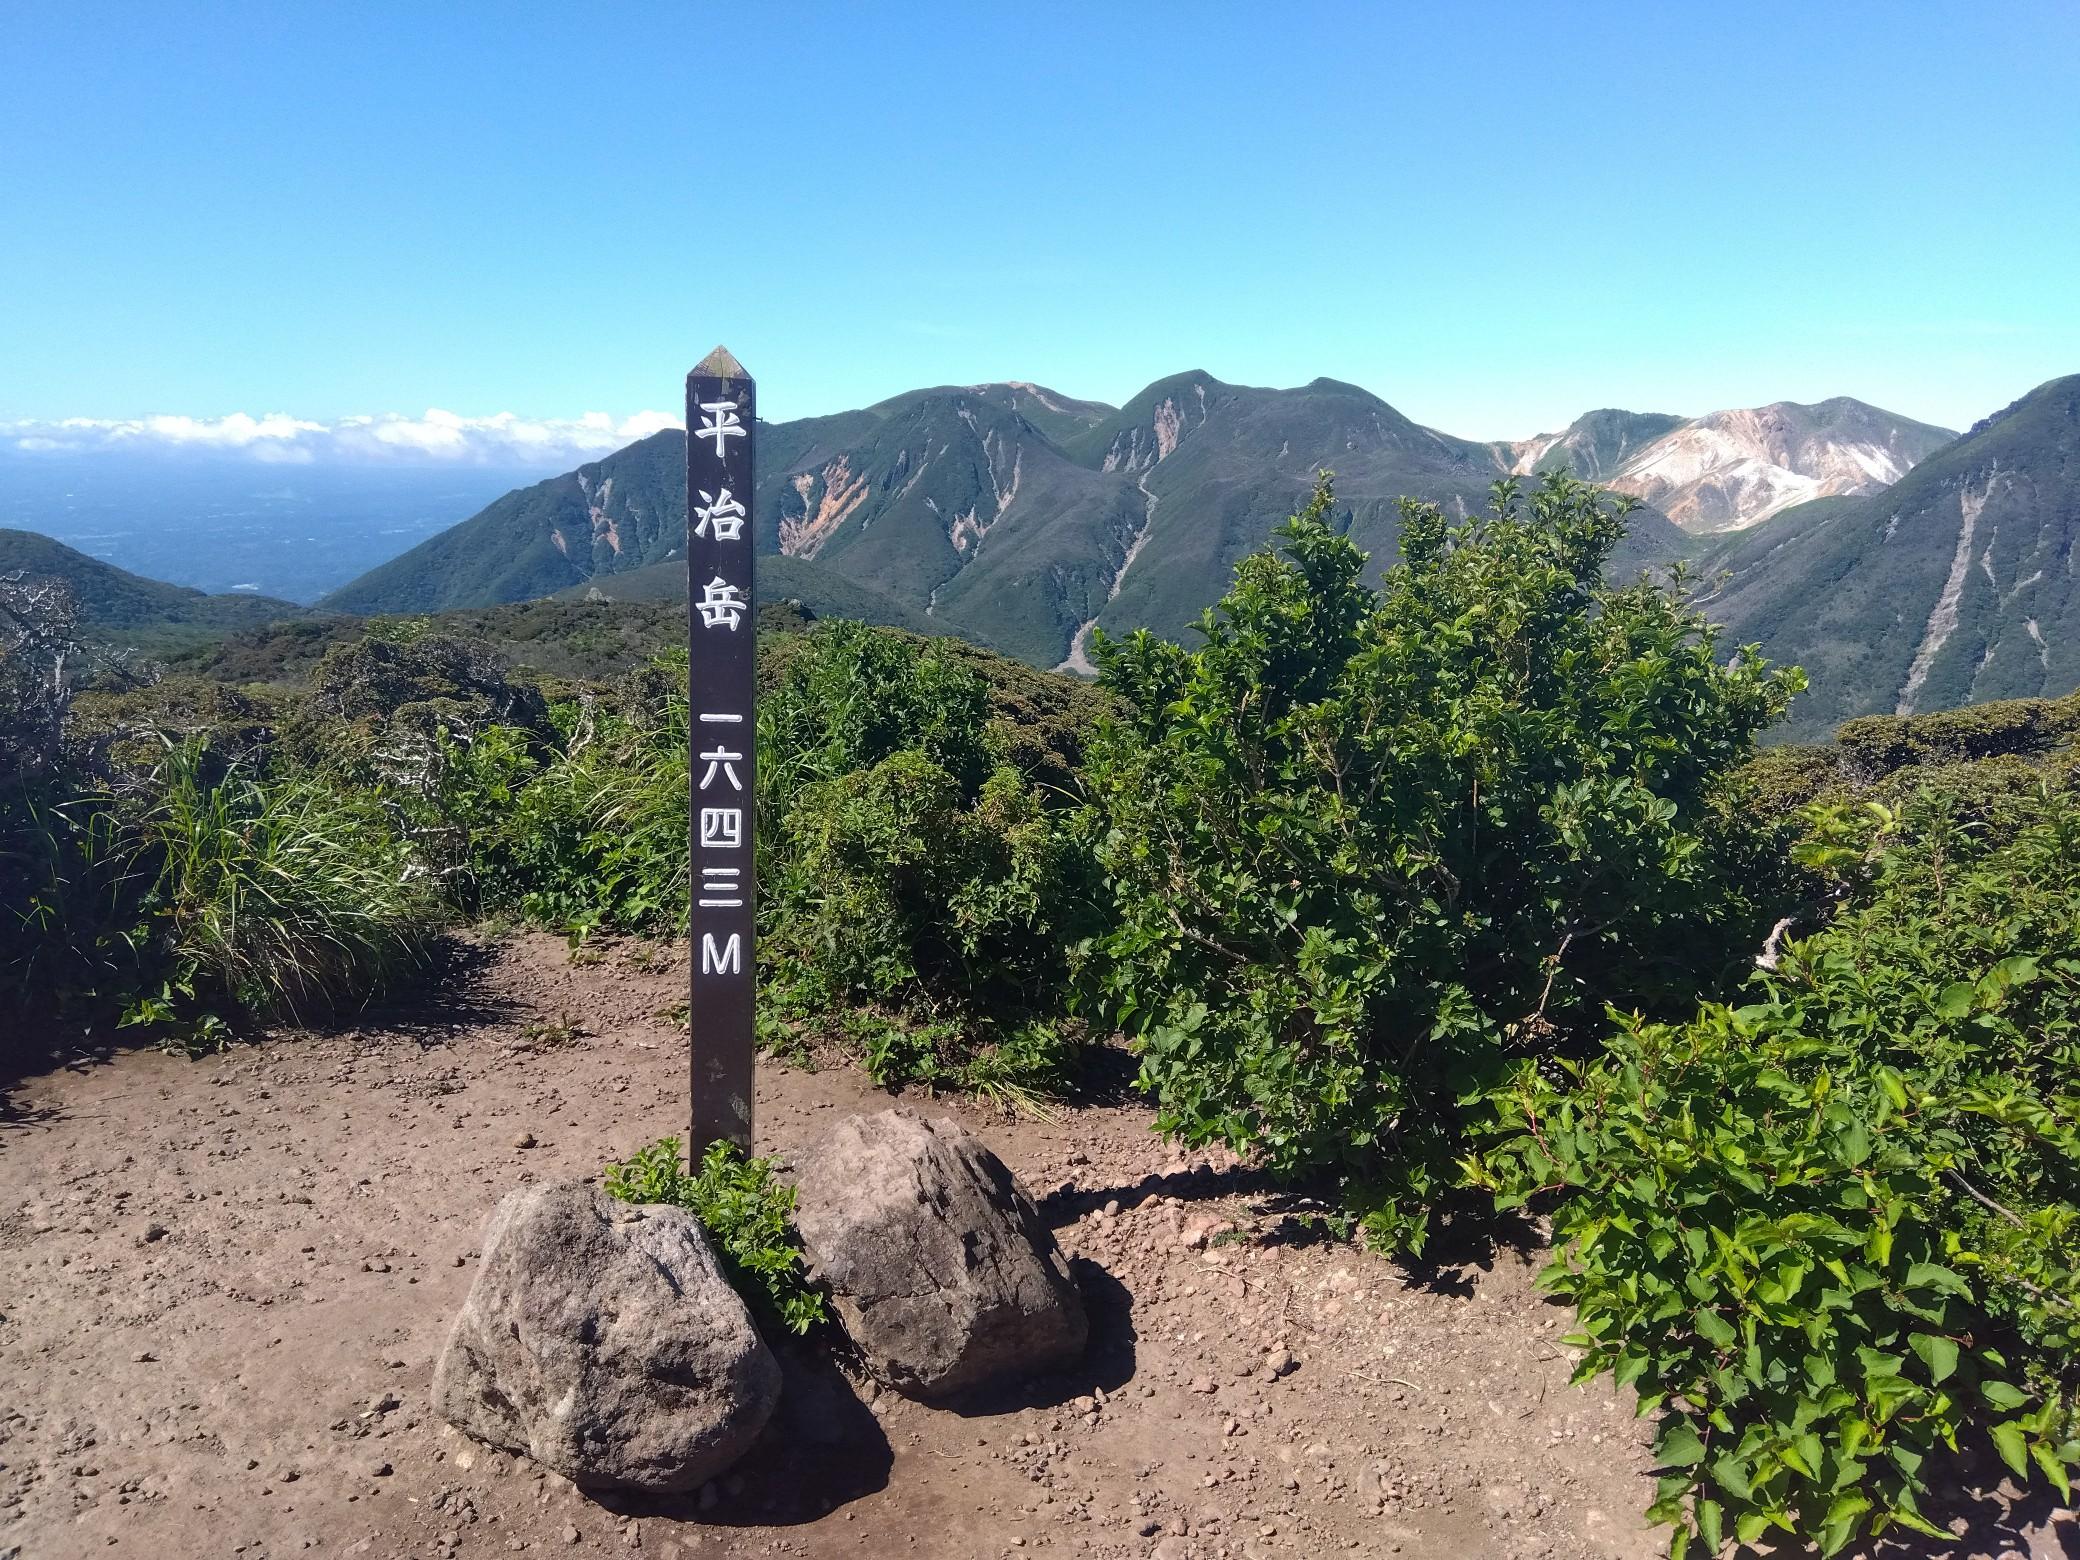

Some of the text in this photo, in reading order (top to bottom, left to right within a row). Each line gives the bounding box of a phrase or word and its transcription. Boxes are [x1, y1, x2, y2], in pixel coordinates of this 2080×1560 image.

[694, 401, 747, 975] 平治岳 一六四三M
